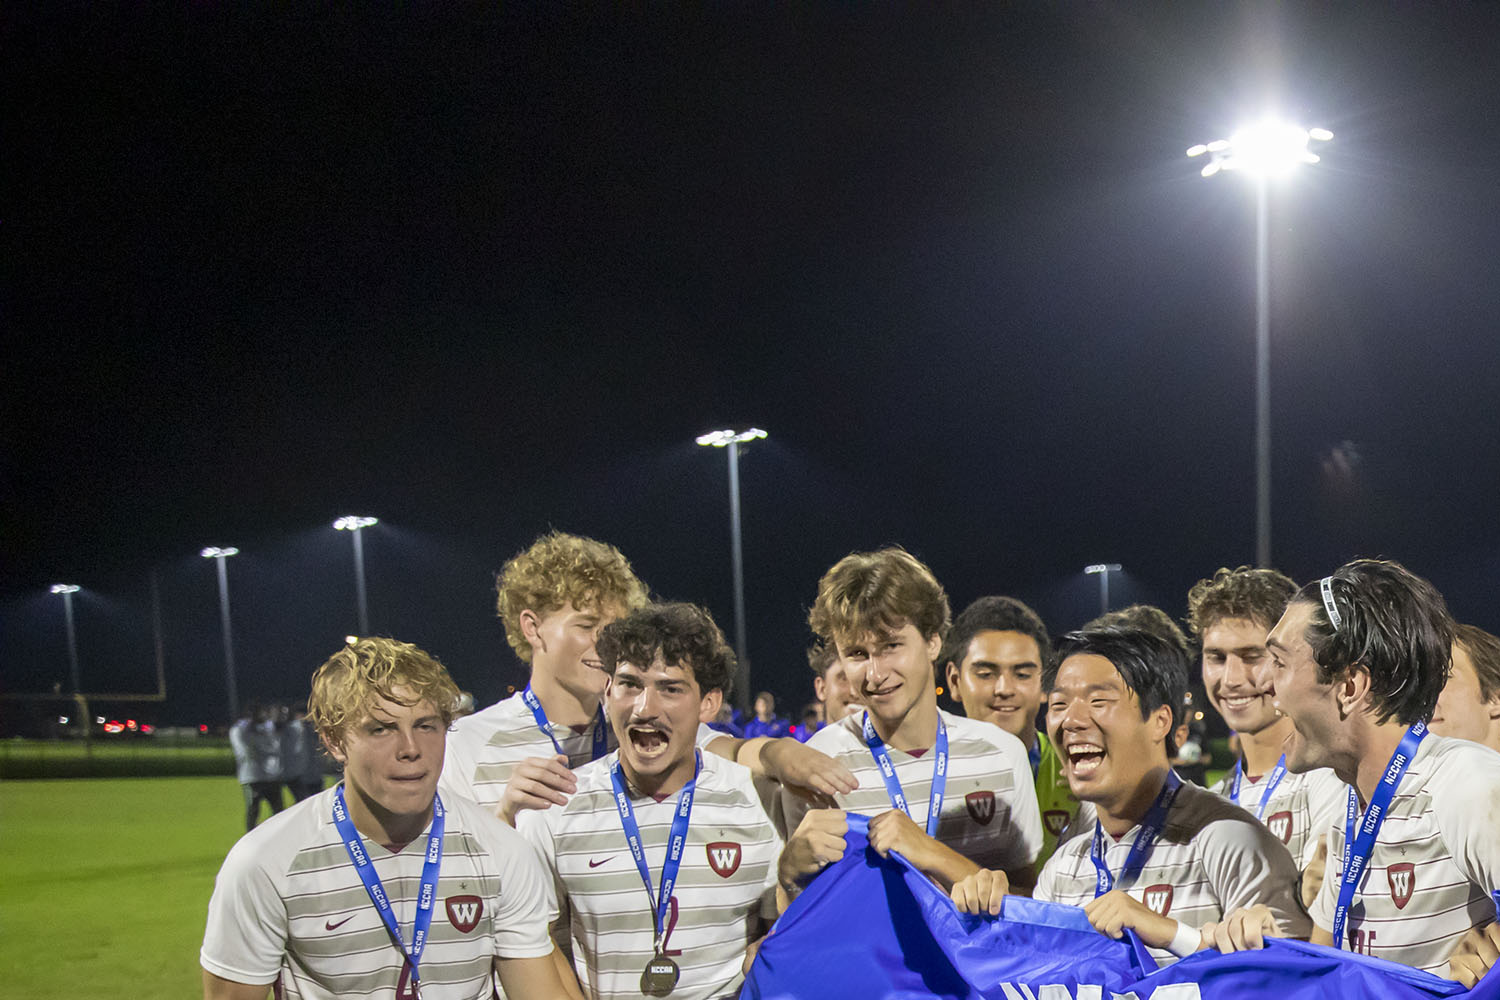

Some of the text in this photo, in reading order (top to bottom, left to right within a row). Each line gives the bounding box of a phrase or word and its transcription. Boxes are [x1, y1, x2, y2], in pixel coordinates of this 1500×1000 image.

[1384, 753, 1406, 785] NCCAA
[679, 792, 691, 817] NCCAA
[968, 797, 992, 817] W
[1363, 803, 1382, 835] NCCAA
[348, 839, 368, 867] NCCAA
[428, 837, 440, 864] NCCAA
[711, 848, 737, 870] W
[1346, 855, 1363, 884] NCCAA
[371, 884, 390, 911] NCCAA
[420, 883, 433, 910] NCCAA
[1391, 872, 1410, 897] W
[451, 903, 478, 924] W
[1146, 891, 1169, 915] W
